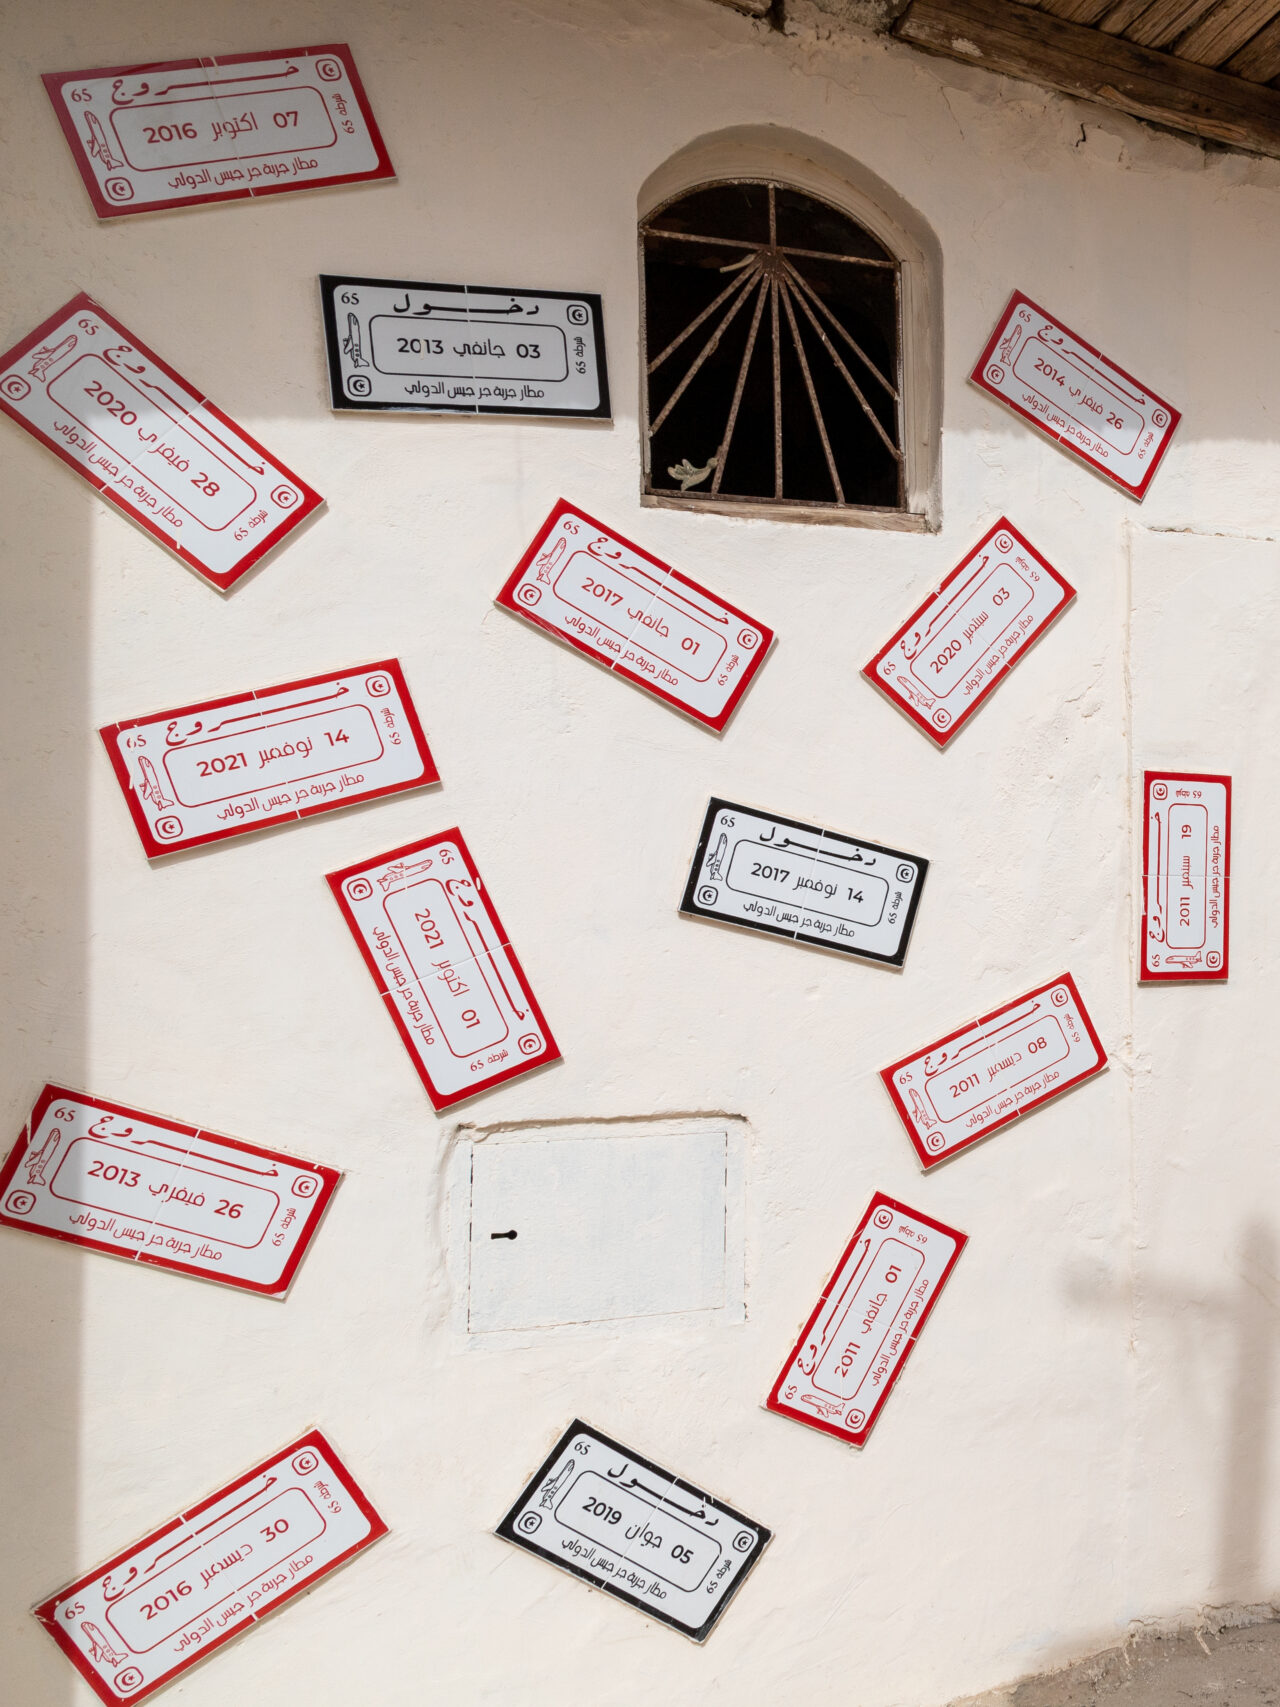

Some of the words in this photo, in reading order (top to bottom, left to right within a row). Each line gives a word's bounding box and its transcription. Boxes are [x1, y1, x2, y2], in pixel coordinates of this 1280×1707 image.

[111, 60, 299, 105] خروج
[70, 87, 92, 102] 65
[211, 111, 259, 142] اكتوبر
[272, 110, 298, 128] 07
[341, 119, 355, 134] 65
[142, 122, 198, 144] 2016
[291, 156, 318, 176] مطار
[167, 168, 212, 189] الدولي
[340, 291, 359, 305] 65
[392, 292, 539, 316] دخول
[1018, 309, 1031, 323] 65
[77, 318, 99, 336] 65
[396, 337, 444, 354] 2013
[452, 338, 506, 358] جانفي
[515, 343, 541, 359] 03
[575, 360, 586, 374] 65
[1033, 357, 1065, 387] 2014
[1036, 324, 1145, 405] خروج
[403, 379, 445, 398] الدولي
[519, 384, 544, 401] مطار
[83, 380, 137, 426] 2020
[102, 345, 265, 475] خروج
[1105, 411, 1124, 430] 26
[53, 421, 97, 453] الدولي
[190, 471, 220, 497] 28
[151, 505, 183, 527] مطار
[233, 527, 248, 541] 65
[562, 520, 580, 535] 65
[580, 576, 623, 606] 2017
[586, 536, 729, 625] خروج
[992, 586, 1010, 606] 03
[899, 554, 989, 660] خروج
[564, 615, 600, 638] الدولي
[626, 607, 669, 638] جانفي
[680, 637, 700, 655] 01
[929, 639, 962, 674] 2020
[652, 668, 678, 685] مطار
[883, 661, 896, 675] 65
[165, 681, 349, 747] خروج
[323, 728, 350, 746] 14
[388, 731, 401, 745] 65
[258, 736, 313, 769] نوفمبر
[196, 752, 248, 777] 2021
[338, 773, 365, 792] مطار
[216, 796, 260, 820] الدولي
[720, 814, 735, 828] 65
[1181, 823, 1192, 839] 19
[438, 848, 454, 865] 65
[758, 826, 876, 866] دخول
[750, 862, 790, 883] 2017
[1148, 811, 1165, 943] خروج
[791, 876, 838, 899] نوفمبر
[847, 887, 864, 903] 14
[742, 900, 776, 917] الدولي
[1179, 896, 1190, 926] 2011
[414, 907, 444, 949] 2021
[832, 923, 854, 937] مطار
[372, 926, 400, 961] الدولي
[444, 878, 529, 1021] خروج
[1151, 953, 1160, 967] 65
[430, 959, 470, 997] اكتوبر
[460, 1009, 480, 1029] 01
[412, 1023, 434, 1045] مطار
[924, 1000, 1041, 1077] خروج
[1027, 1036, 1047, 1054] 08
[469, 1059, 484, 1071] 65
[899, 1071, 912, 1084] 65
[949, 1073, 980, 1098] 2011
[53, 1106, 76, 1122] 65
[87, 1115, 279, 1177] خروج
[87, 1160, 141, 1187] 2013
[213, 1199, 244, 1219] 26
[68, 1211, 116, 1231] الدولي
[271, 1232, 285, 1246] 65
[190, 1243, 222, 1260] مطار
[884, 1264, 902, 1283] 01
[796, 1237, 871, 1376] خروج
[834, 1341, 861, 1378] 2011
[784, 1384, 797, 1400] 65
[573, 1441, 591, 1455] 65
[606, 1463, 719, 1526] دخول
[581, 1496, 622, 1525] 2019
[101, 1474, 278, 1602] خروج
[259, 1518, 289, 1542] 30
[624, 1522, 662, 1549] جوان
[561, 1539, 596, 1560] الدولي
[670, 1544, 694, 1564] 05
[199, 1543, 253, 1589] ديسمبر
[288, 1554, 313, 1580] مطار
[139, 1579, 192, 1620] 2016
[642, 1581, 667, 1599] مطار
[64, 1601, 85, 1619] 65
[173, 1617, 214, 1651] الدولي
